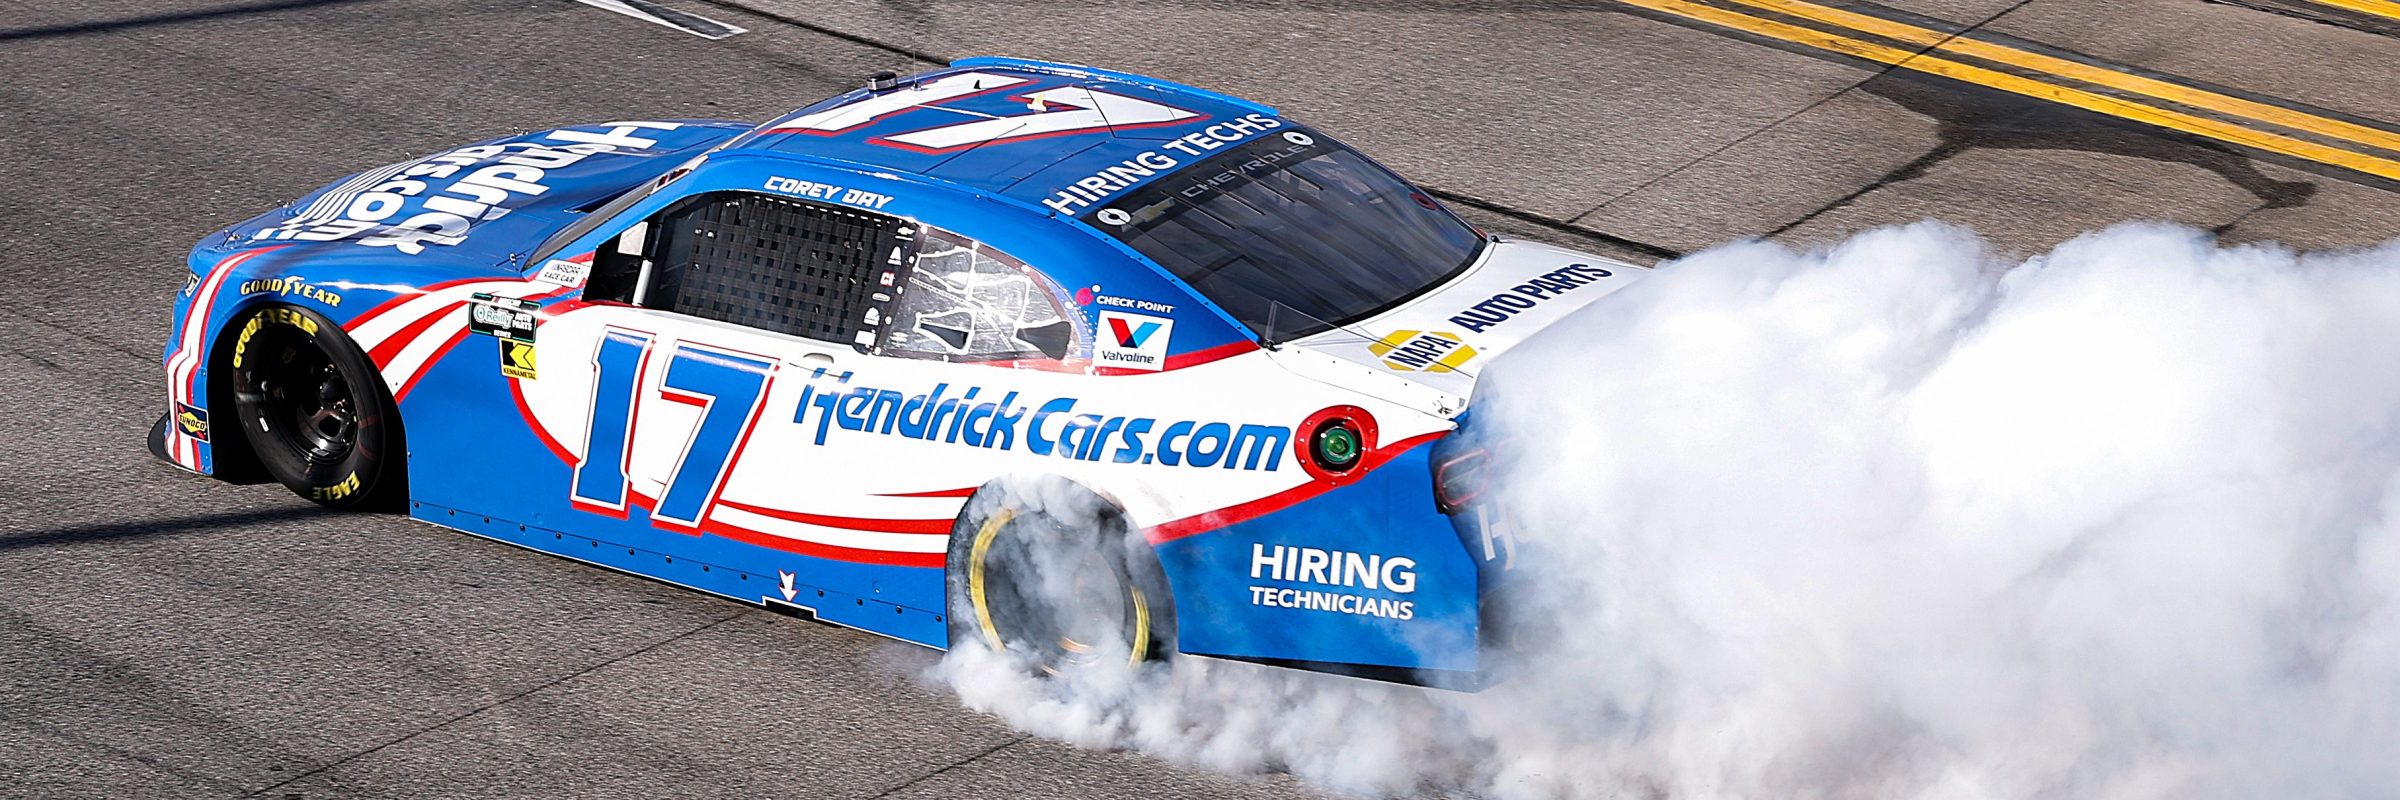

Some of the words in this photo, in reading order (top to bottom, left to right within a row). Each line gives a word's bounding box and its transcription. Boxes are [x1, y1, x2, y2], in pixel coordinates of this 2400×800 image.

[757, 71, 1212, 154] 17
[1045, 151, 1179, 216] HIRING
[1162, 113, 1282, 157] TECHS
[1181, 145, 1316, 198] CHEVROLE
[763, 175, 843, 200] COREY
[841, 188, 895, 209] DAY
[240, 276, 342, 307] GOODYEAR
[543, 271, 560, 281] RACE
[560, 274, 576, 284] CAR
[1096, 295, 1135, 308] CHECK
[1136, 300, 1175, 313] POINT
[1387, 335, 1459, 368] NAPA
[1448, 293, 1537, 334] AUTO
[1524, 263, 1613, 300] PARTS
[503, 367, 537, 380] KENNAMETAL
[1102, 350, 1155, 364] Valvoline
[178, 414, 207, 430] SUNOCO
[570, 324, 781, 537] 17
[312, 470, 361, 500] EAGLE
[1250, 543, 1416, 594] HIRING
[1249, 586, 1414, 621] TECHNICIANS
